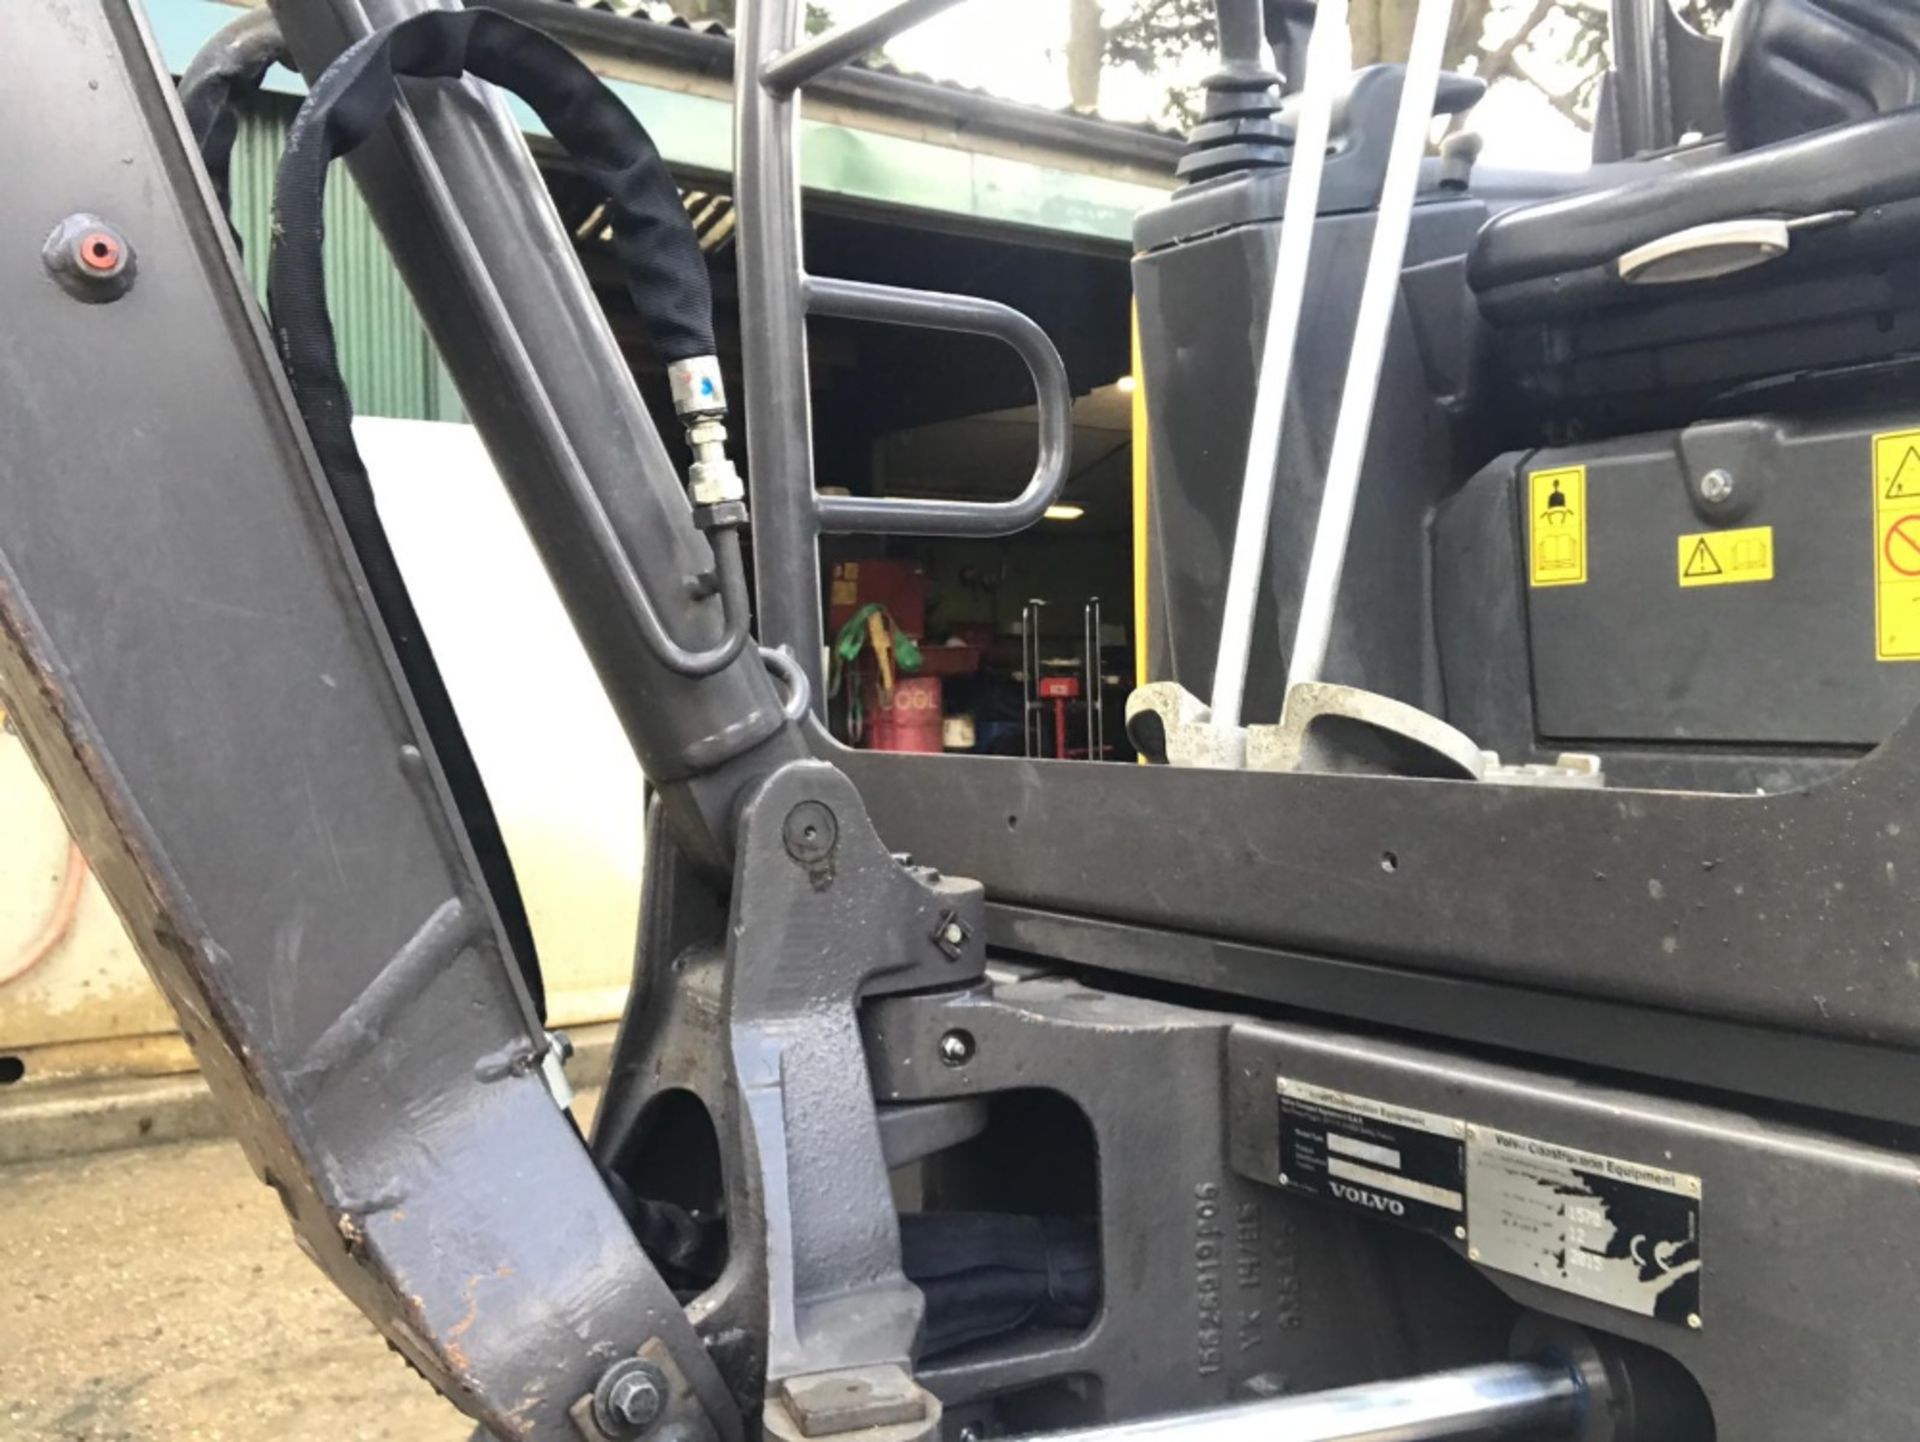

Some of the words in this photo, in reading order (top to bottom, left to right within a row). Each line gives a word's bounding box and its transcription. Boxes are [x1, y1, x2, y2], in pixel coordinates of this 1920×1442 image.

[1495, 1134, 1526, 1151] Volv
[1607, 1160, 1677, 1188] Equipment
[1328, 1181, 1405, 1216] VOLVO
